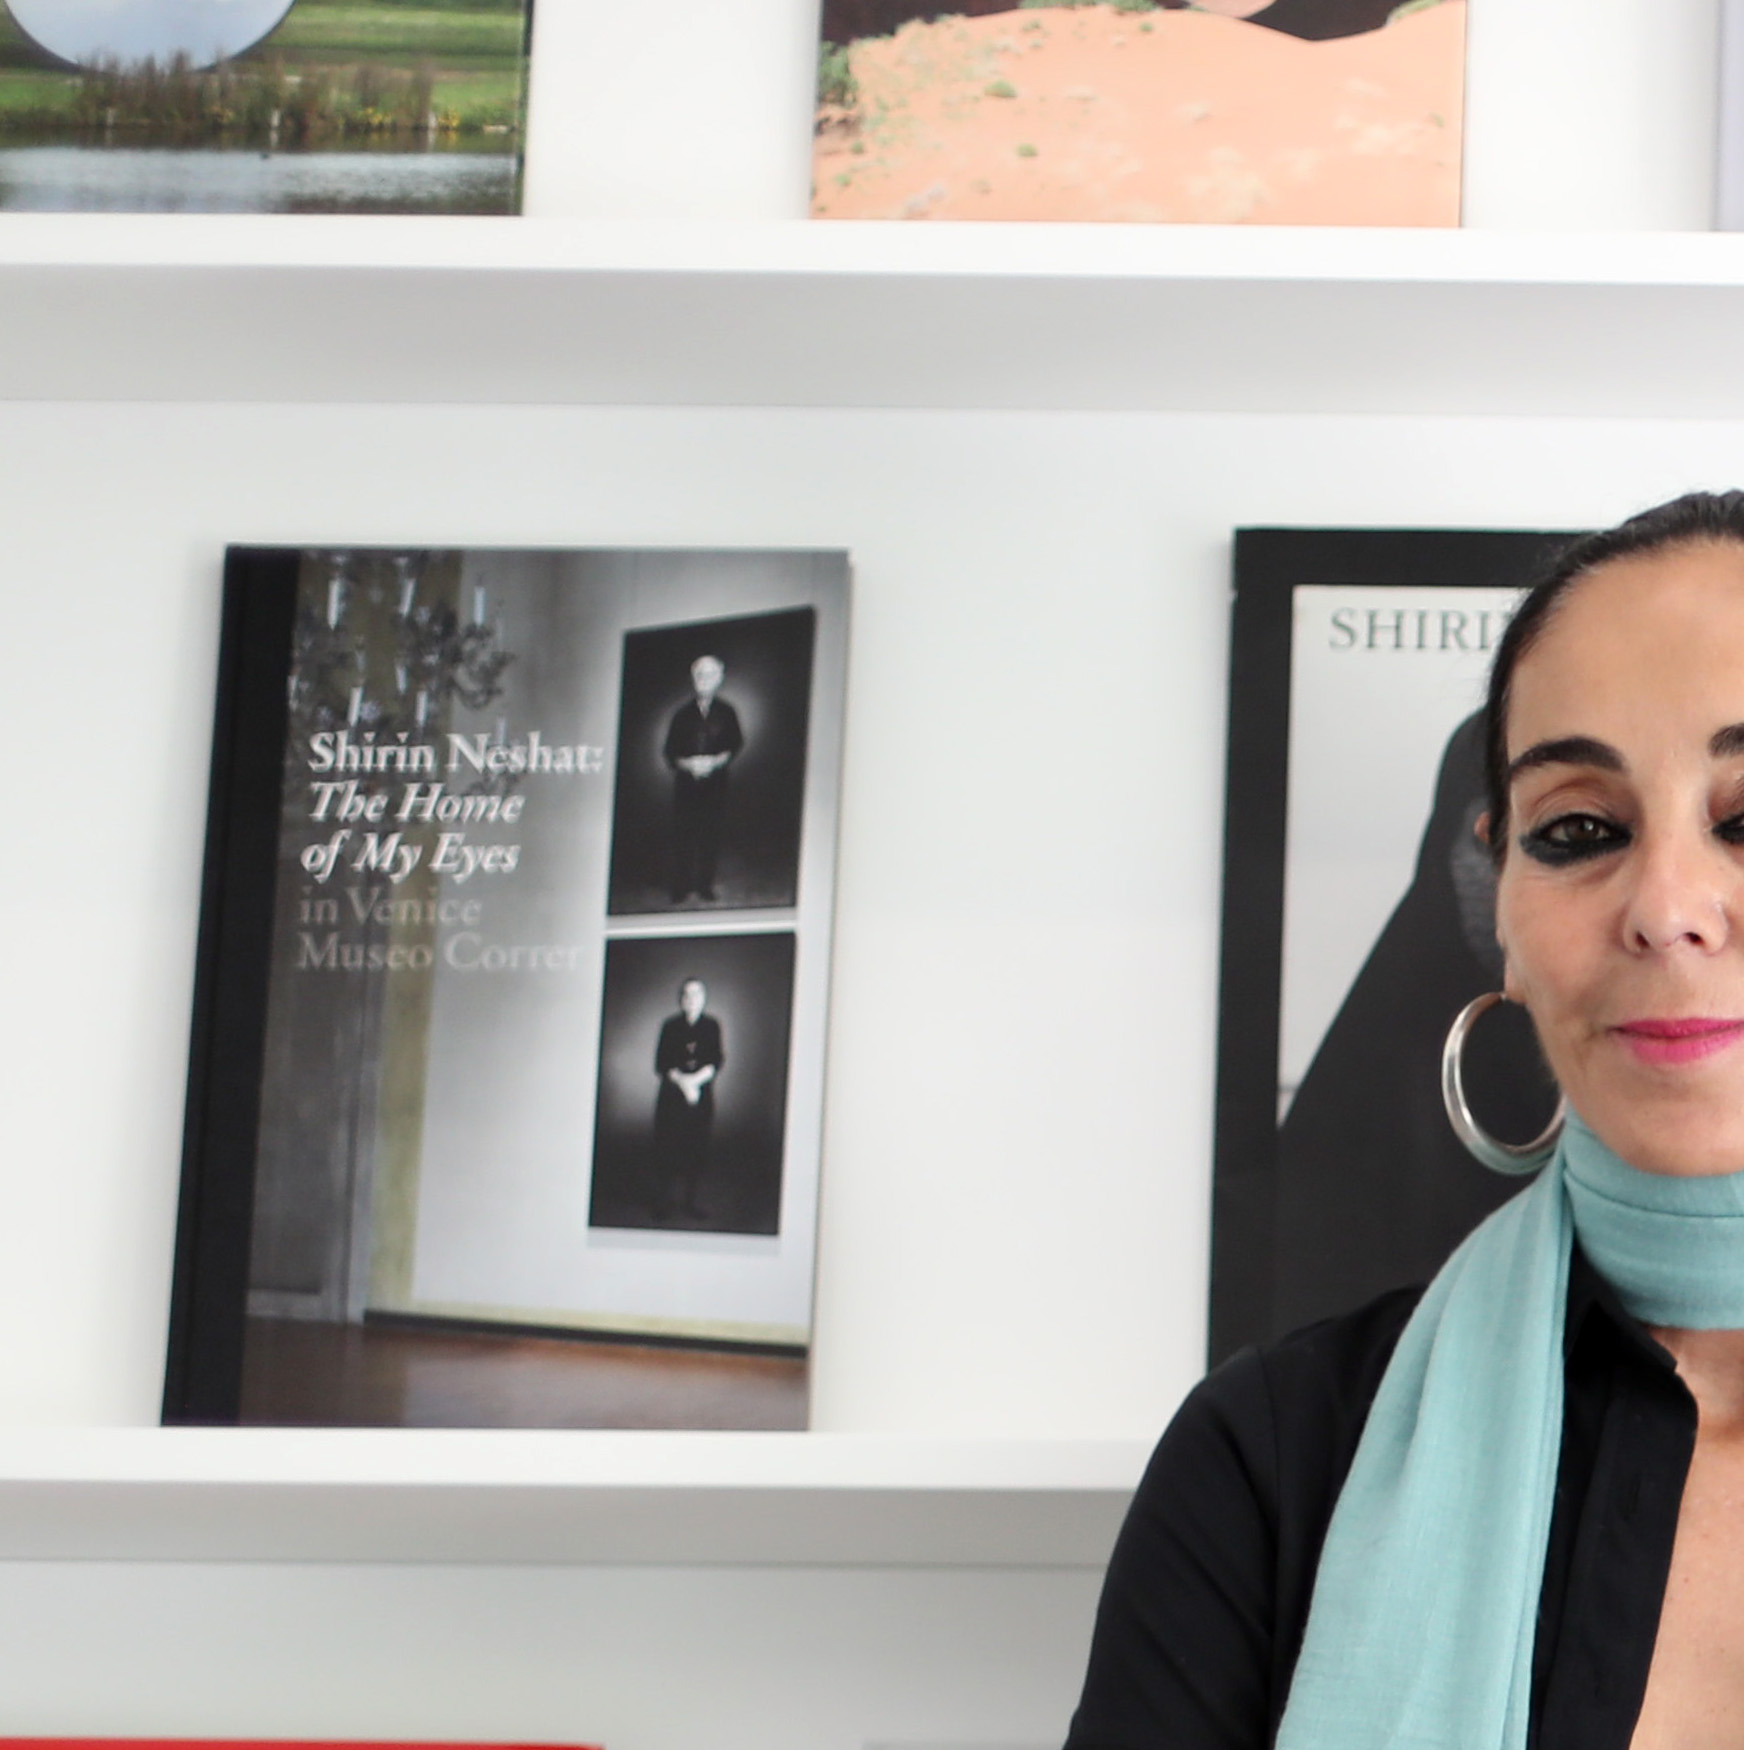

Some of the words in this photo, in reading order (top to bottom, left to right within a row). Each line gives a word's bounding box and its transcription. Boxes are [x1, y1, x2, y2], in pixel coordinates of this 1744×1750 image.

[1328, 607, 1512, 651] SHIRI
[308, 732, 435, 773] Shirin
[446, 730, 604, 774] Neshat:
[309, 780, 390, 823] The
[395, 782, 525, 824] Home
[301, 829, 352, 884] of
[354, 832, 424, 884] My
[428, 832, 520, 884] Eyes
[302, 888, 341, 926] in
[345, 887, 482, 928] Venice
[297, 933, 434, 972] Museo
